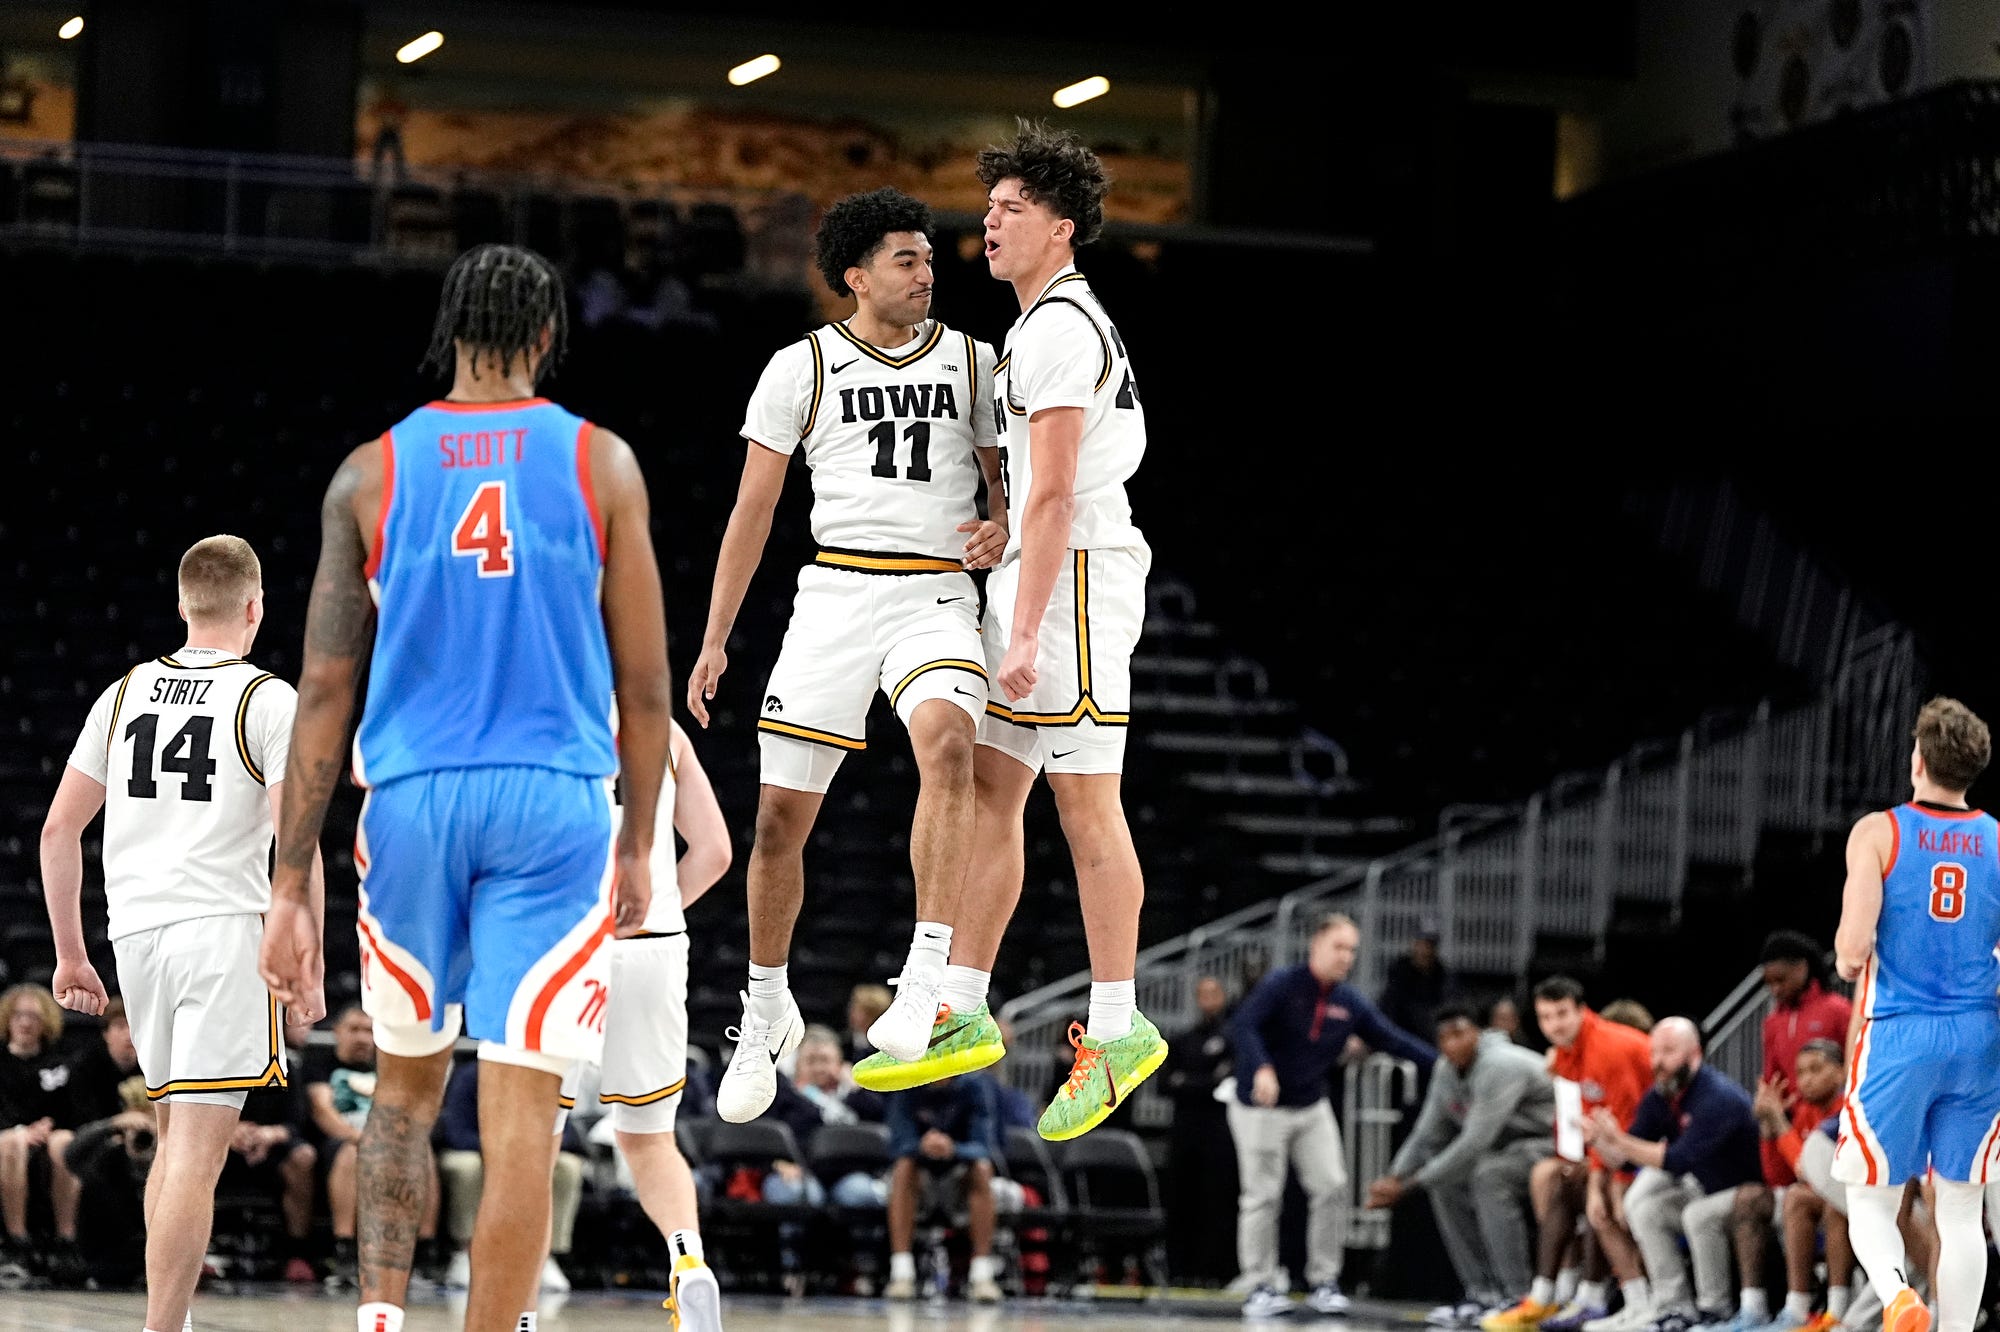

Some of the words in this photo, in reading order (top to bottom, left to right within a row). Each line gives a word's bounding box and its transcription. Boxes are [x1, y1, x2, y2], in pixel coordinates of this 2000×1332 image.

[839, 383, 959, 423] IOWA
[439, 428, 528, 469] SCOTT
[868, 420, 931, 482] 11
[451, 480, 515, 579] 4
[149, 677, 214, 705] STIRTZ
[124, 713, 216, 802] 14
[1918, 828, 1983, 857] KLAFKE
[1928, 861, 1967, 923] 8
